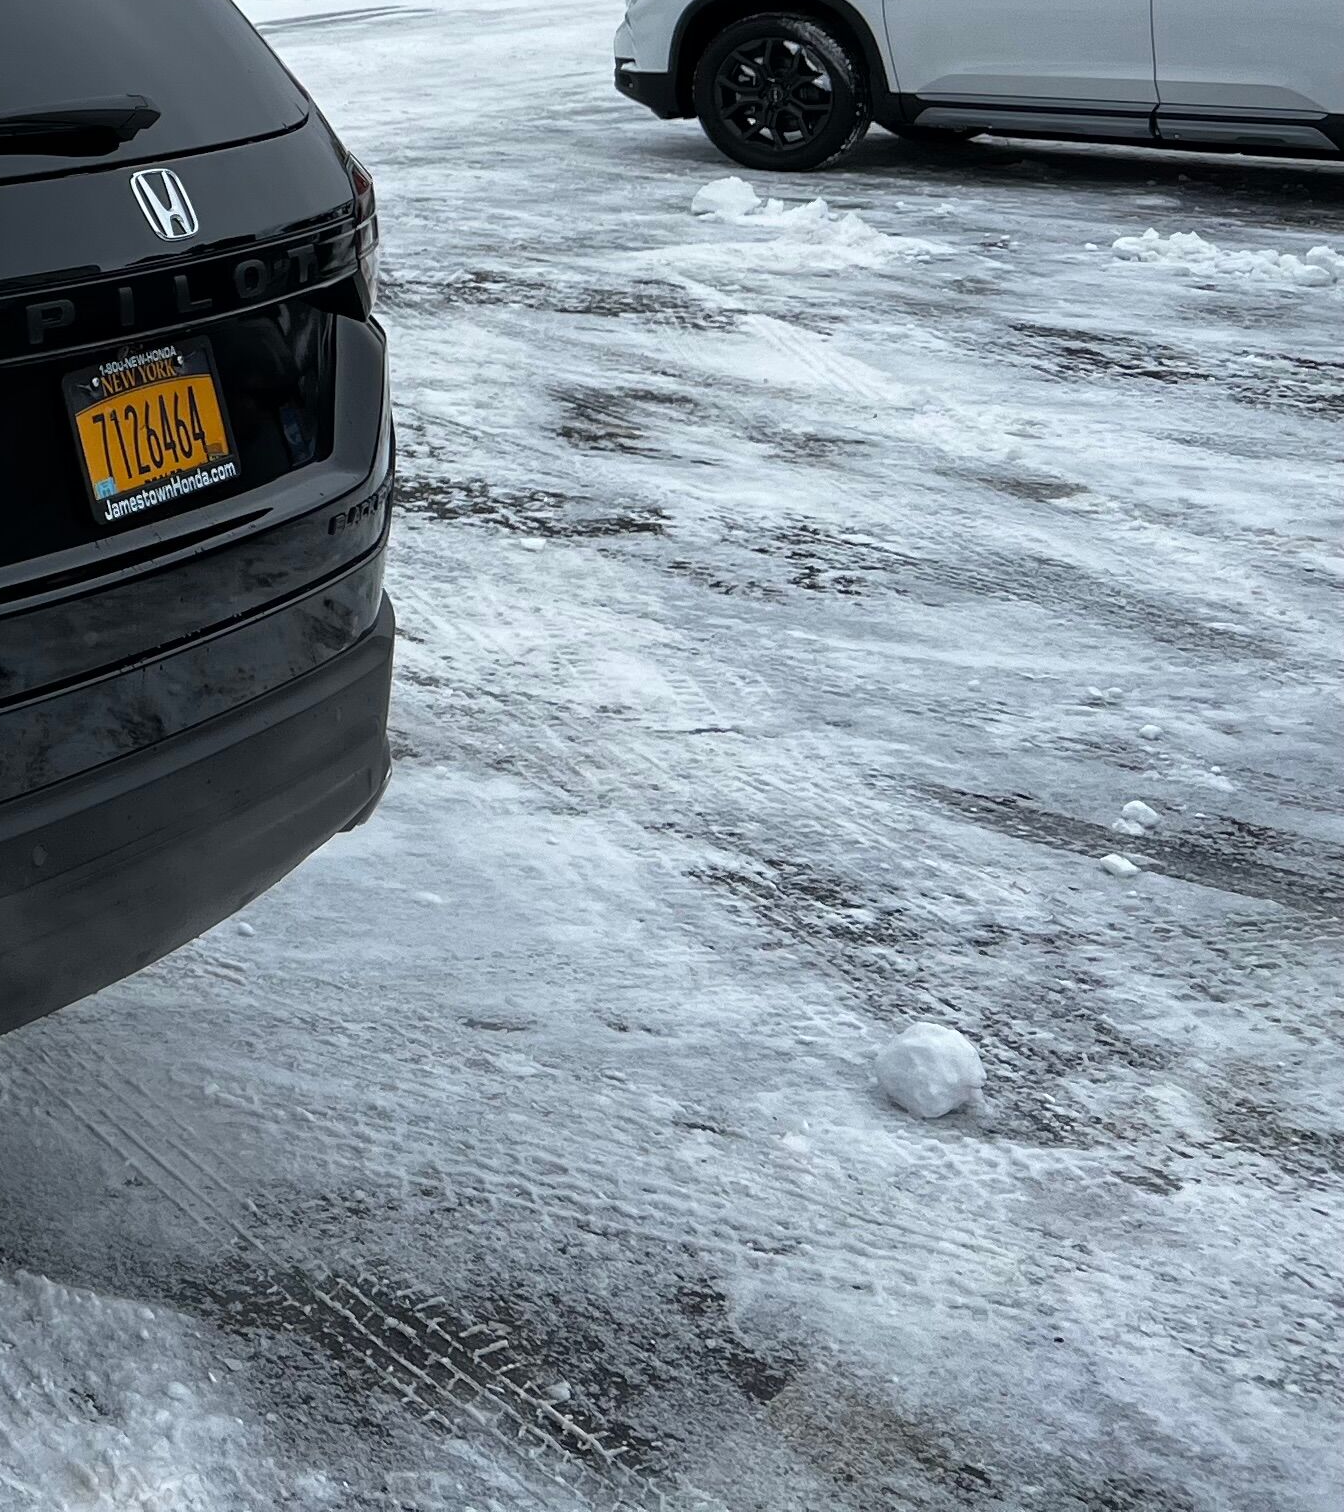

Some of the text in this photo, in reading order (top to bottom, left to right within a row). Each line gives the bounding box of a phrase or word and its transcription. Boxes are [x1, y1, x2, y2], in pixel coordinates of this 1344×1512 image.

[25, 244, 318, 345] PILOT
[100, 358, 177, 397] NEW YORK
[92, 386, 211, 481] 7126464
[104, 461, 237, 521] JamestownHonda.com
